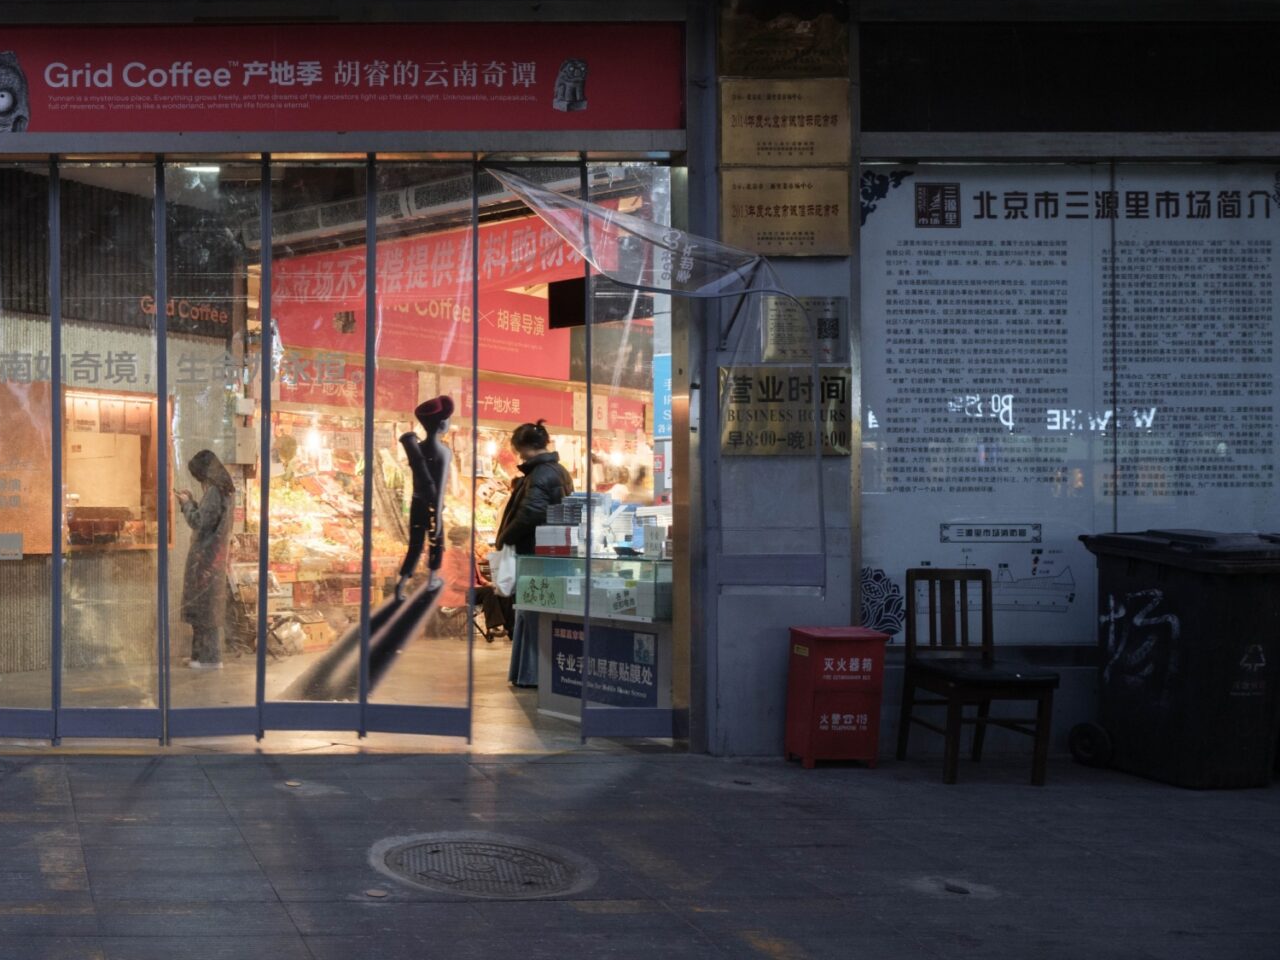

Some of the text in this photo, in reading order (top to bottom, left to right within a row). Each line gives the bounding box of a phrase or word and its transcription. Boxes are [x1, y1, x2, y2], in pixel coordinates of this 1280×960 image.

[44, 61, 113, 89] Grid
[242, 60, 538, 88] 产地季 胡睿的云南奇谭
[972, 189, 1272, 220] 北京市三源里市场简介
[140, 295, 174, 316] Gd
[728, 375, 847, 404] 营业时间
[728, 409, 793, 423] BUSINESS
[823, 657, 873, 672] 灭火器箱
